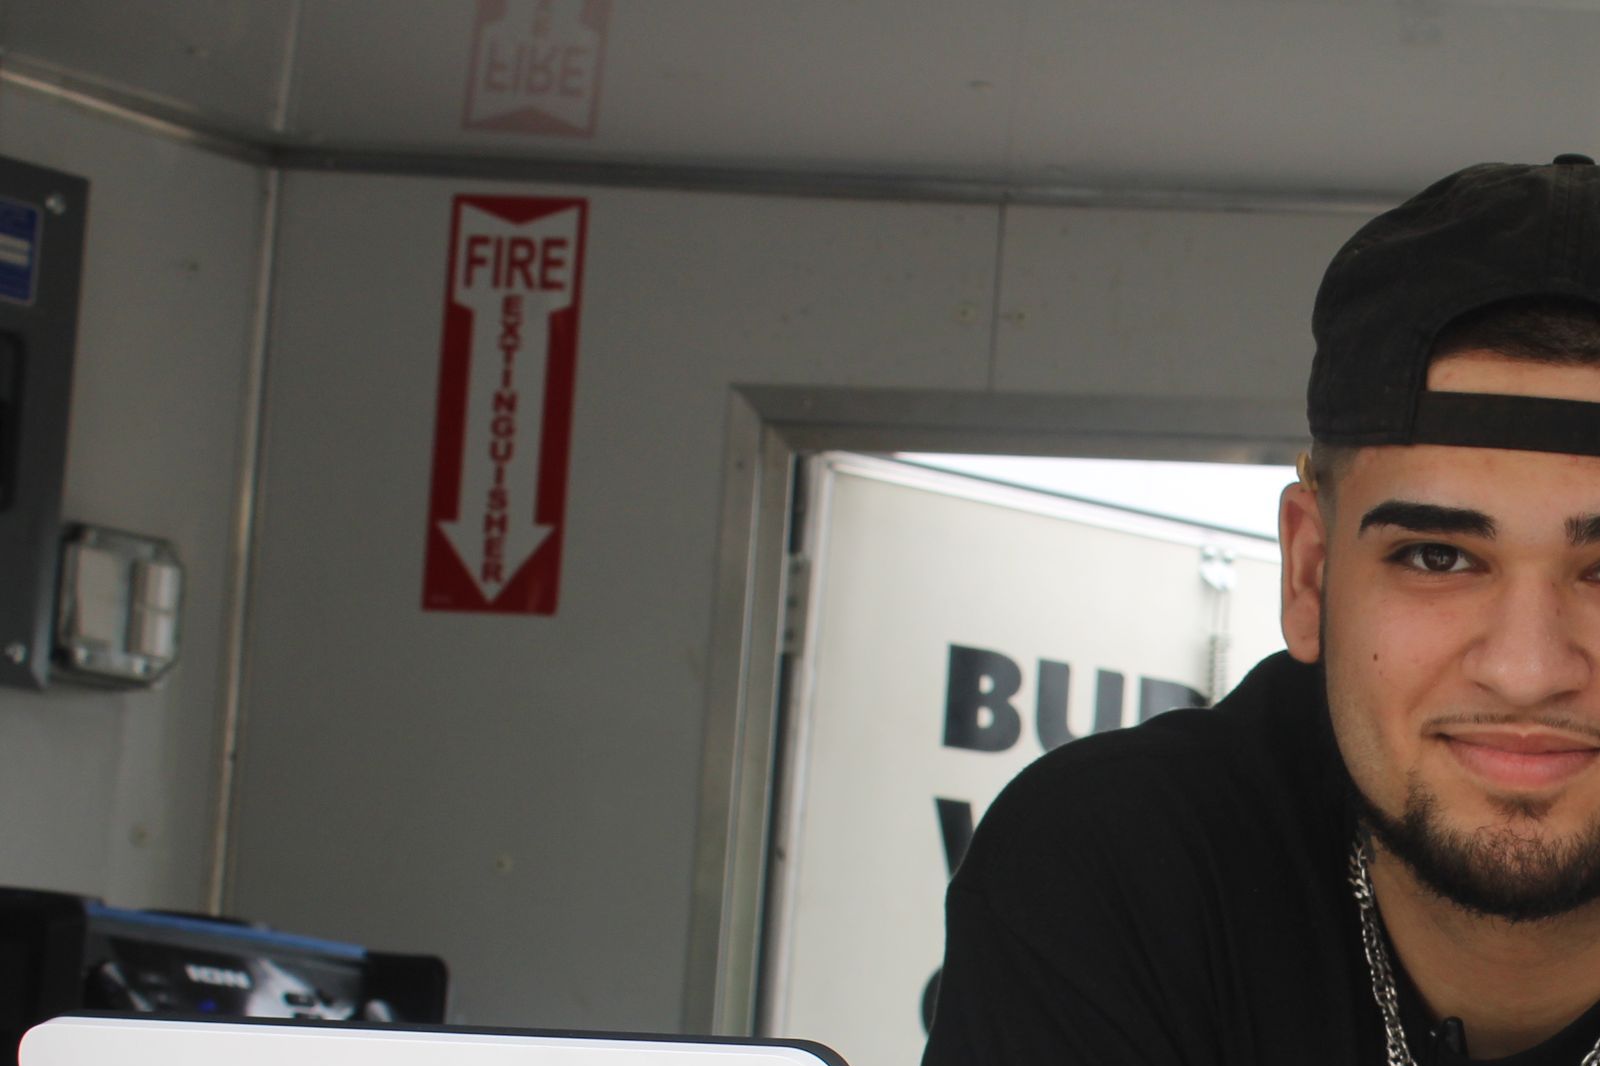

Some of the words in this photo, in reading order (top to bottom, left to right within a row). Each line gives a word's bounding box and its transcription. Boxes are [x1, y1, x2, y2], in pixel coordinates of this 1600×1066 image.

[463, 235, 568, 291] FIRE
[481, 294, 523, 584] EXTINGUISHER
[940, 642, 1210, 754] BU
